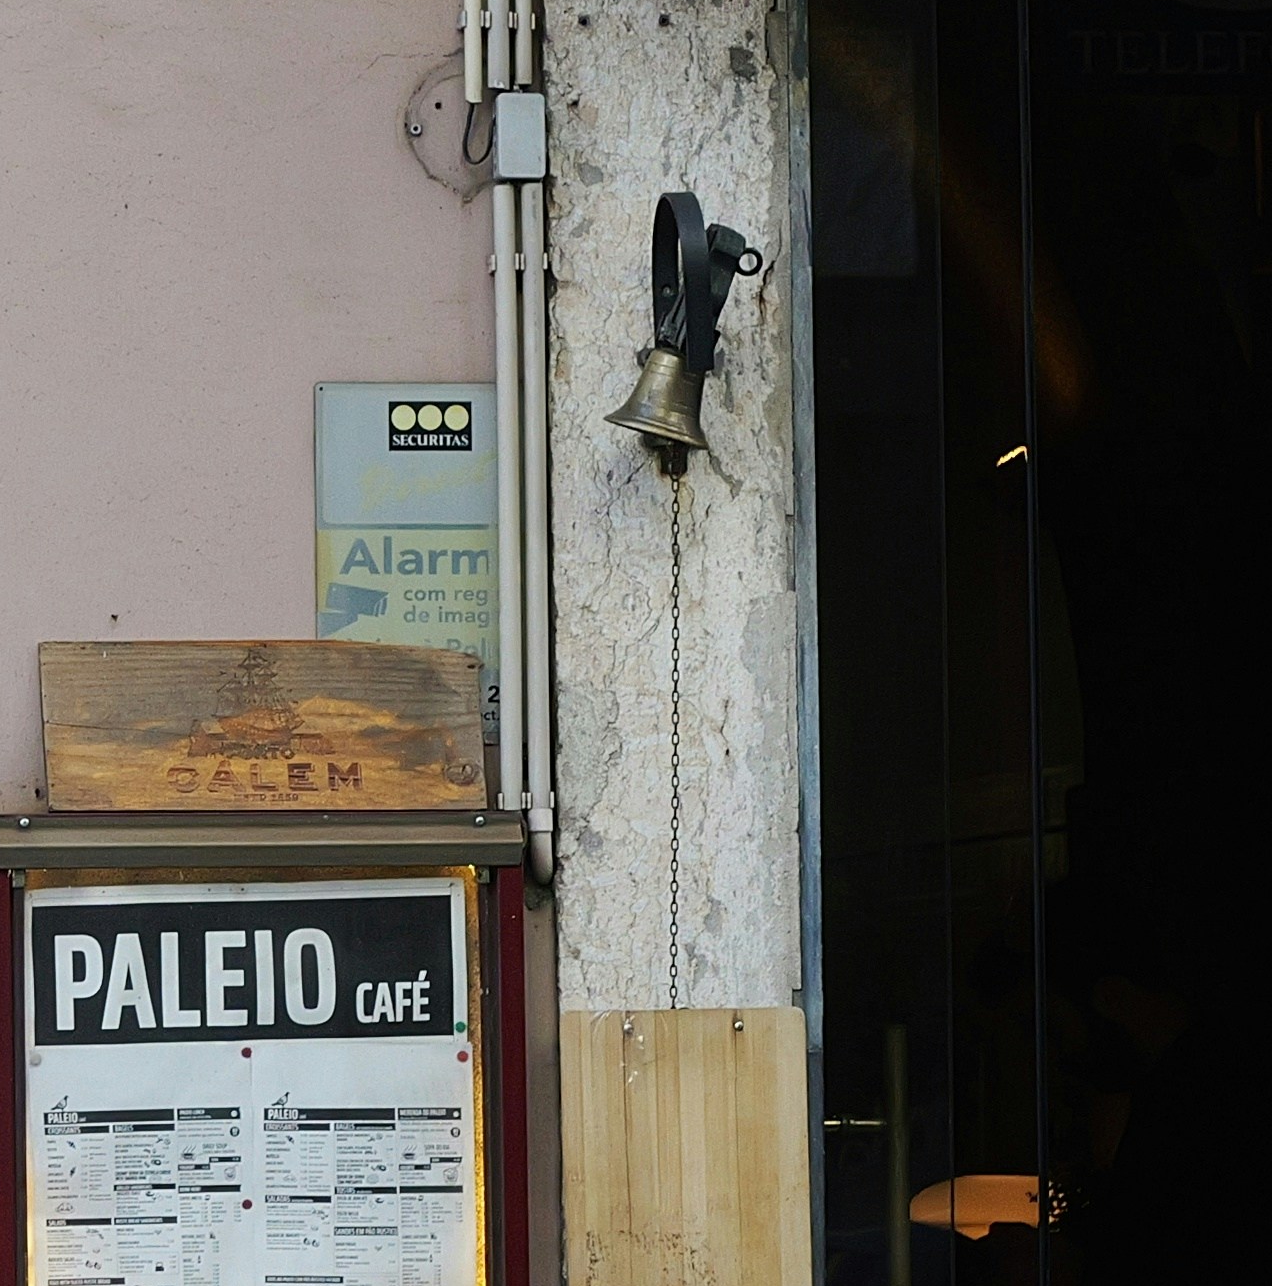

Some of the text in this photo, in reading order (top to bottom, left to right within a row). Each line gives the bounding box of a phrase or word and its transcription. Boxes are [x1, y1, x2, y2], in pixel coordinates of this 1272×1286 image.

[392, 434, 469, 447] SECURITAS
[403, 589, 446, 602] com
[403, 605, 430, 623] de
[54, 927, 431, 1031] PALEIO CAFÉ
[48, 1112, 78, 1124] PALEIO
[267, 1110, 298, 1121] PALEIO
